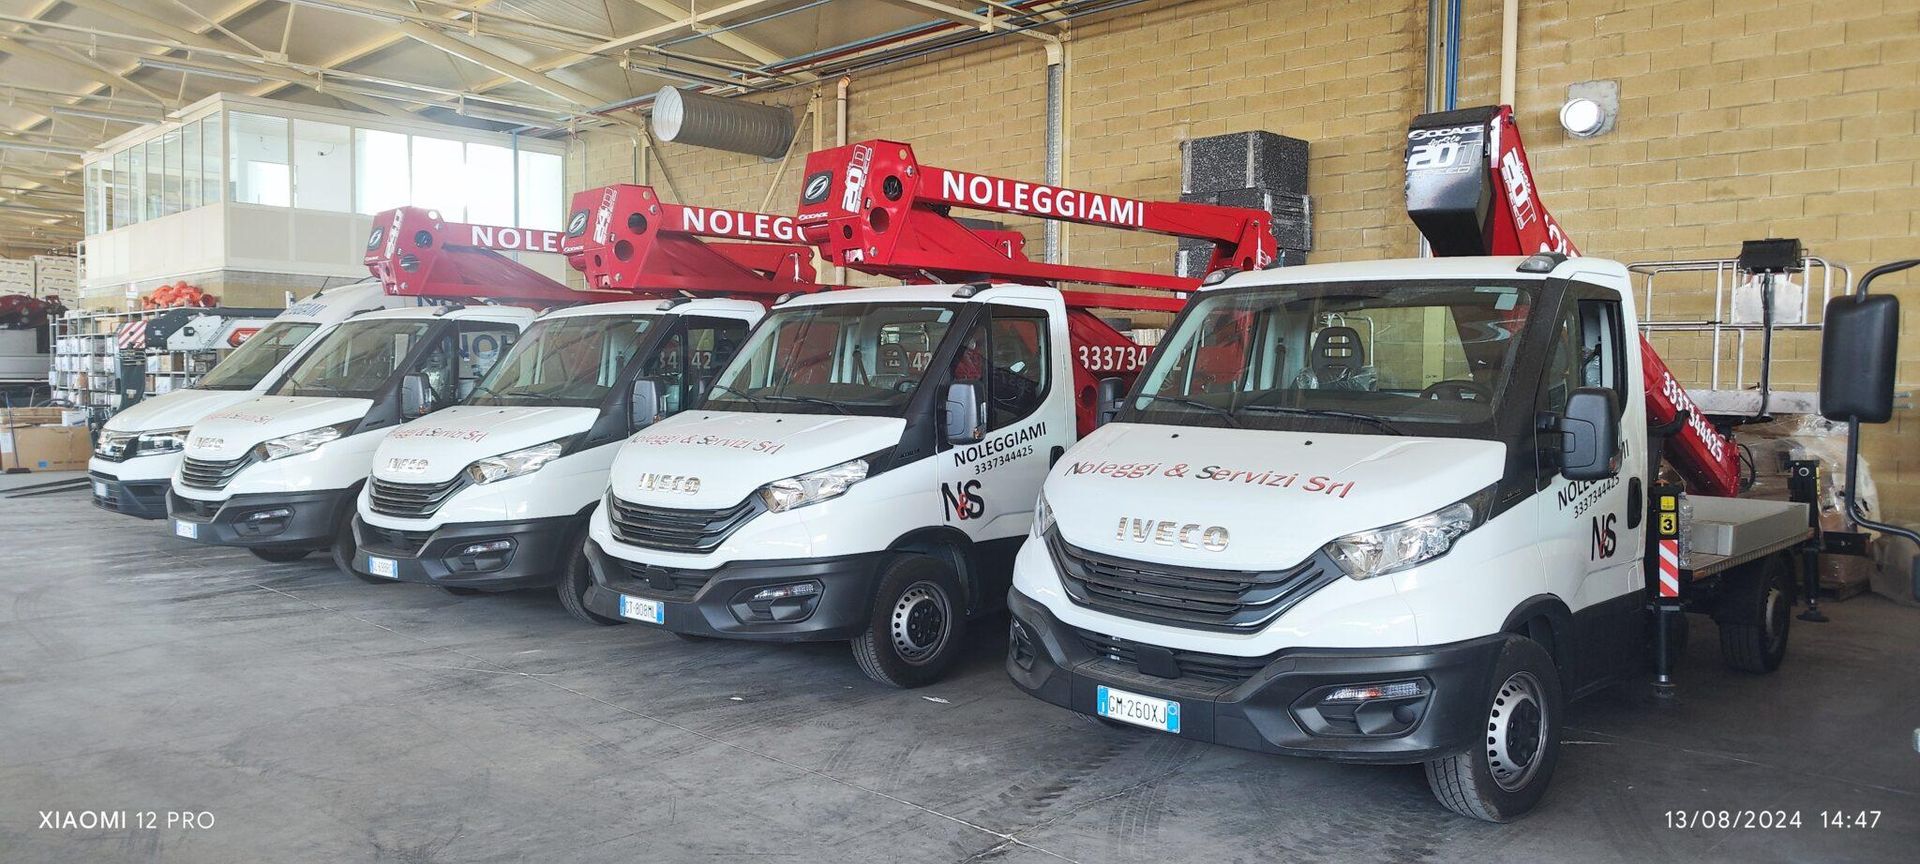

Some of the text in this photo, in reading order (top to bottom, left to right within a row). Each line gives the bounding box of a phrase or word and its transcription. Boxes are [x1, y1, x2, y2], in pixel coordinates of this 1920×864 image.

[942, 170, 1144, 227] NOLEGGIAMI
[471, 226, 567, 252] NOLE
[682, 207, 806, 241] NOLEG
[753, 440, 785, 455] Srl
[954, 421, 1047, 467] NOLEGGIAMI
[974, 445, 1034, 475] 3337344425
[638, 471, 701, 496] IVECO
[1064, 460, 1355, 499] Noleggi & Servizi Srl
[1115, 516, 1230, 552] IVECO
[1663, 518, 1673, 531] 3
